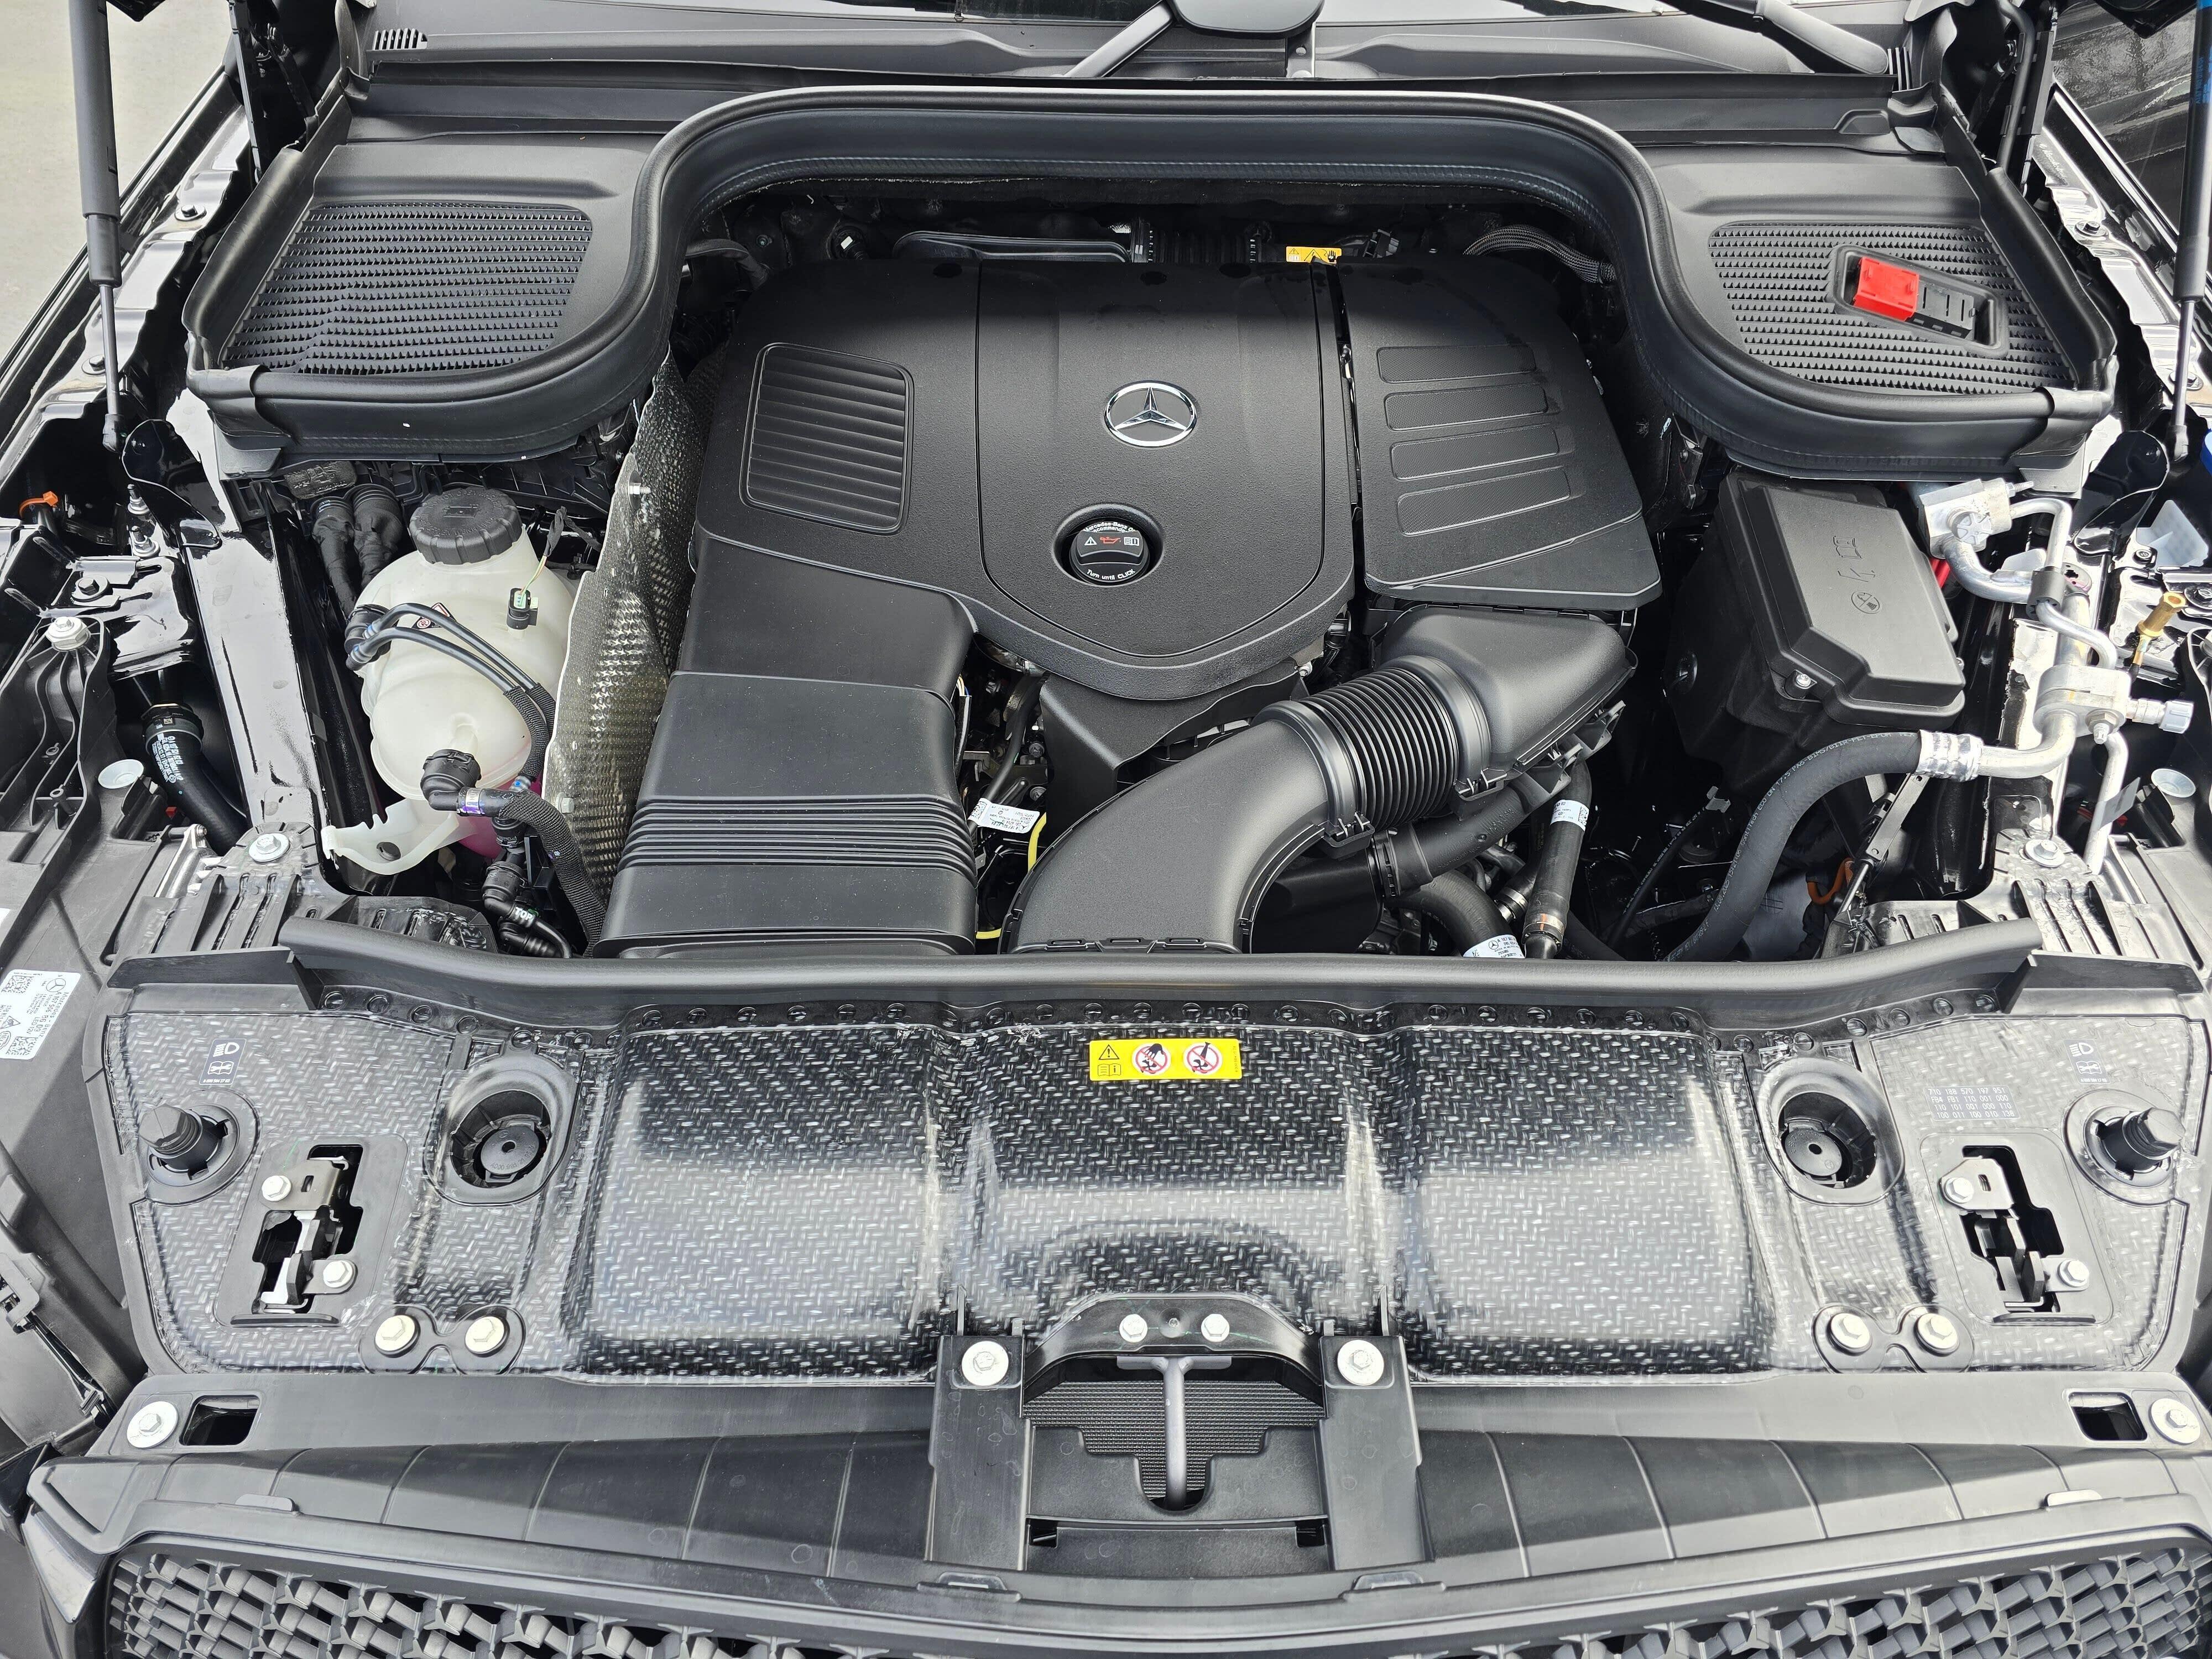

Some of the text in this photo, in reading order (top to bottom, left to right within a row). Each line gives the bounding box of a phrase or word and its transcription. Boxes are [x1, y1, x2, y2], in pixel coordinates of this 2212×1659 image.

[1087, 569, 1100, 578] Turn
[1117, 568, 1136, 580] CLICK
[515, 906, 533, 921] TOP
[50, 992, 69, 1018] Mercedes
[39, 1024, 51, 1037] Benz
